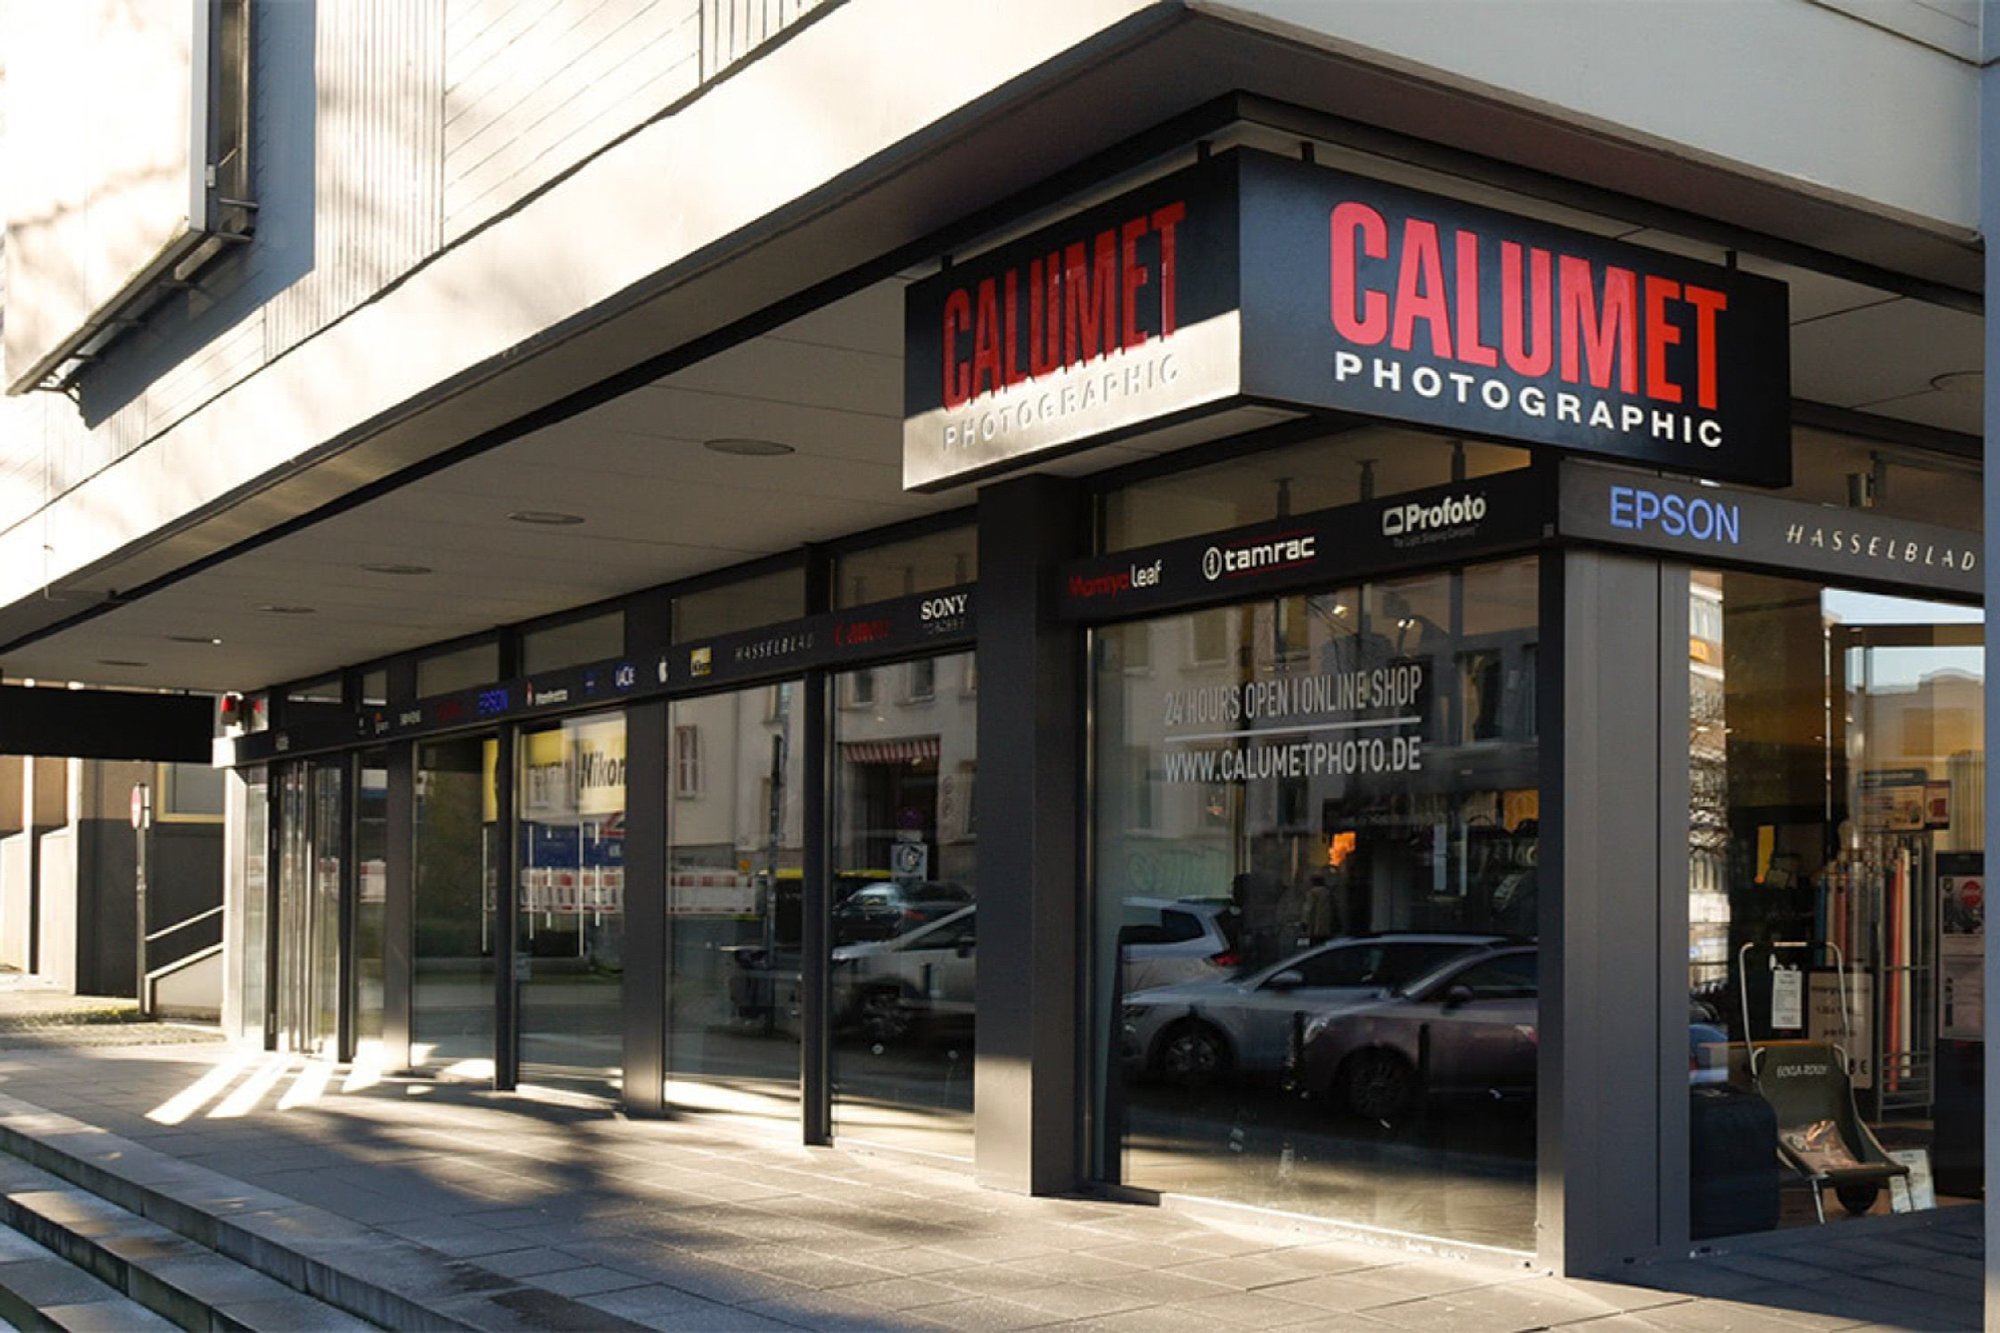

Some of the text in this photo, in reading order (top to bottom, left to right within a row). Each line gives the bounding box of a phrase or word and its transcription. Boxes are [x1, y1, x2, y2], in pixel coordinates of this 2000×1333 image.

[941, 202, 1186, 413] CALUMET
[1329, 200, 1727, 411] CALUMET
[943, 353, 1180, 452] PHOTOGRAPHIC
[1334, 350, 1724, 449] PHOTOGRAPHIC
[1405, 494, 1487, 532] Profoto
[1609, 486, 1740, 544] EPSON
[1225, 536, 1315, 571] tamrac
[1785, 524, 1977, 572] HASSELBLAD
[920, 594, 968, 620] SONY
[735, 631, 815, 661] HASSELBLAD
[1164, 692, 1183, 726] 24
[1188, 685, 1240, 722] HOURS
[1245, 678, 1288, 719] OPEN
[1301, 671, 1367, 715] ONLINE
[1371, 665, 1422, 708] SHOP
[1164, 736, 1422, 783] WWW.CALUMETPHOTO.DE
